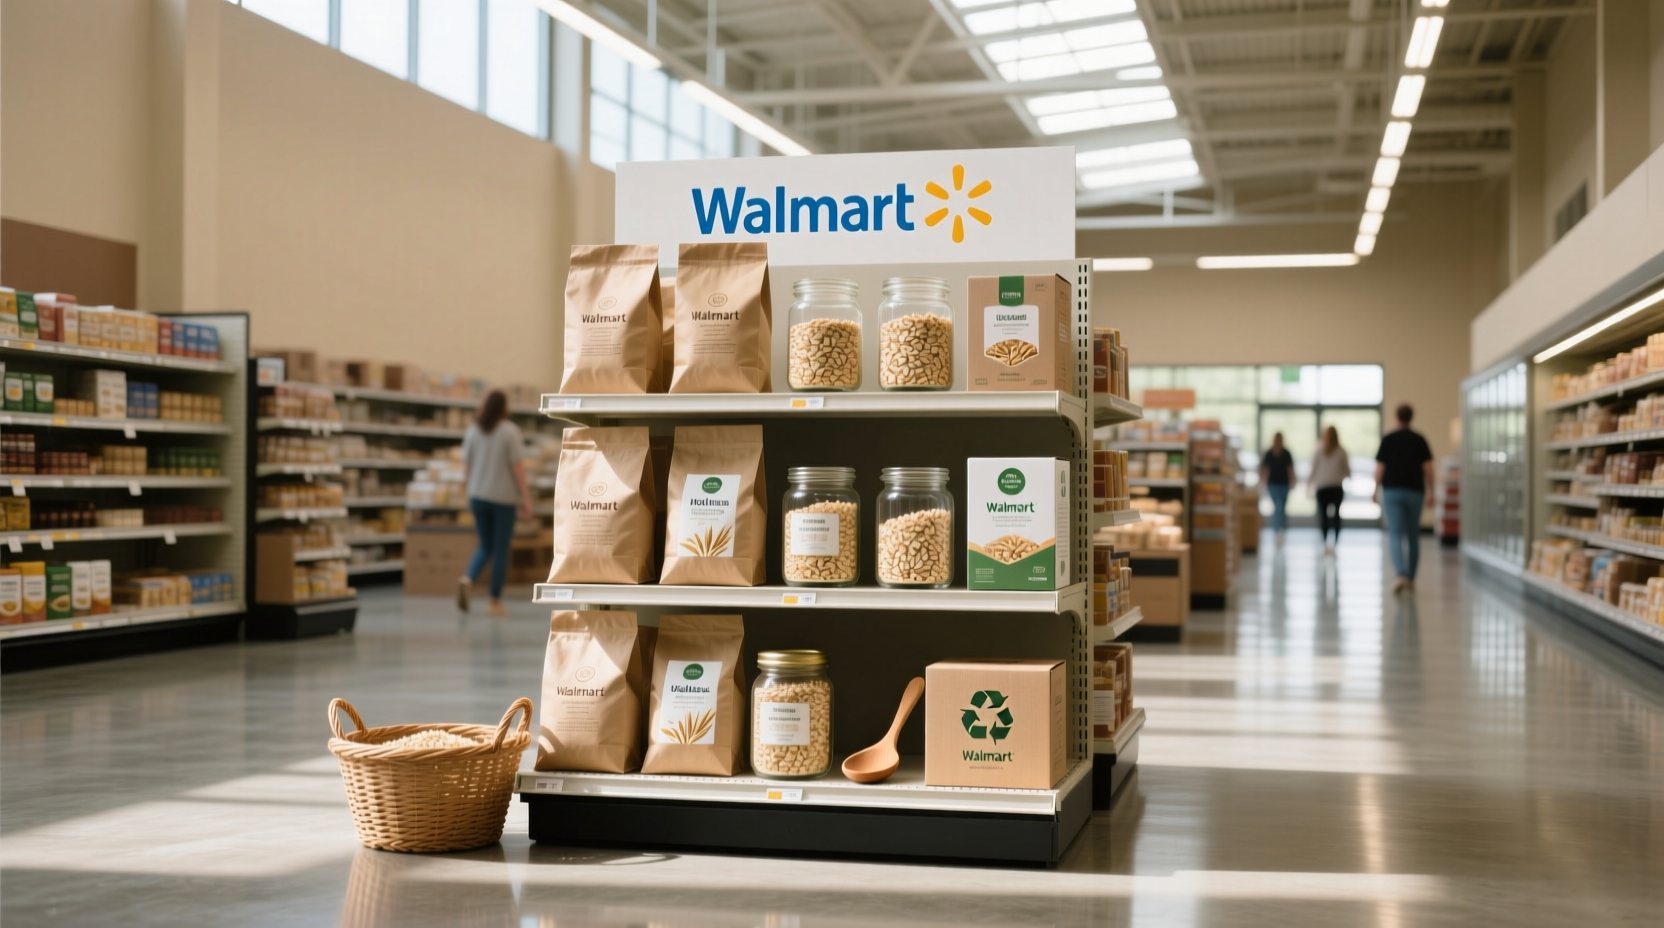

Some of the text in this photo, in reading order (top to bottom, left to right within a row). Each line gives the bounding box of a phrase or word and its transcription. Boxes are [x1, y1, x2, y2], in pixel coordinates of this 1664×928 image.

[692, 183, 915, 235] Walmart
[692, 310, 740, 321] Walmart
[570, 500, 618, 511] Walmart
[962, 749, 1013, 762] Walmart
